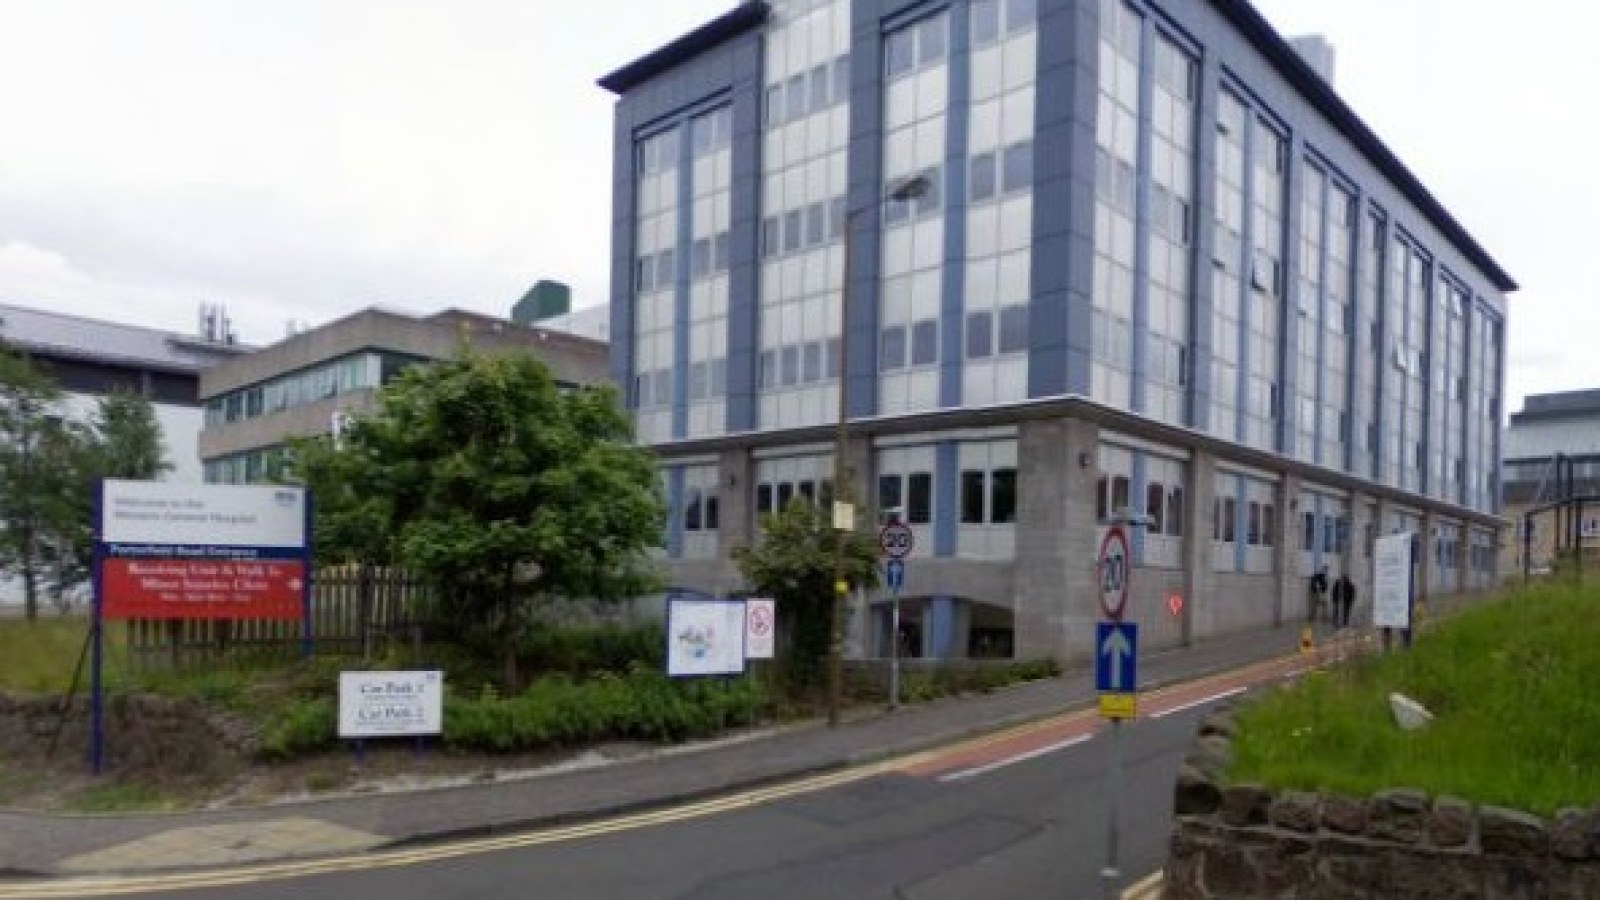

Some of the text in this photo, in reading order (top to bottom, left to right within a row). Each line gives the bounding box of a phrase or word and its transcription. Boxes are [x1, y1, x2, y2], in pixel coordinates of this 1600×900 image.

[888, 533, 907, 547] 20
[1103, 555, 1123, 593] 20
[360, 683, 383, 694] Car
[385, 682, 413, 694] Park
[358, 707, 383, 719] Car
[385, 707, 412, 719] Park
